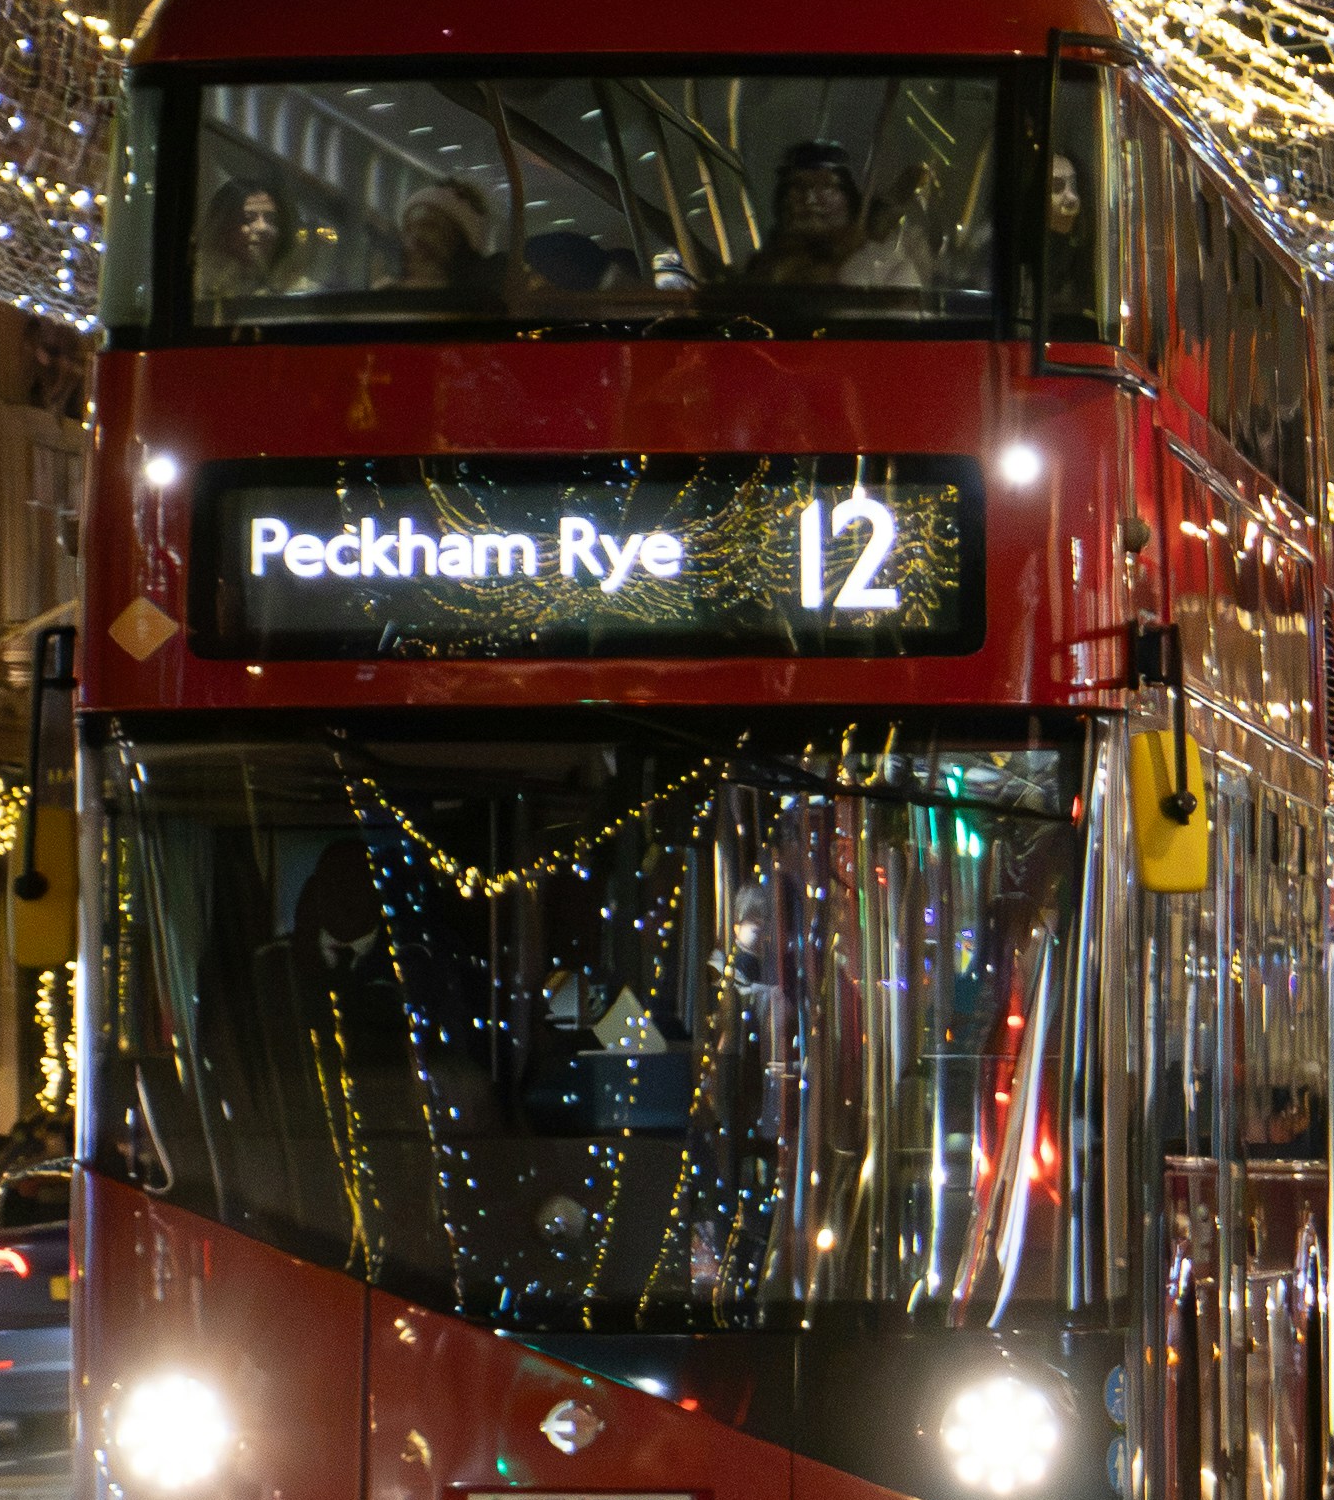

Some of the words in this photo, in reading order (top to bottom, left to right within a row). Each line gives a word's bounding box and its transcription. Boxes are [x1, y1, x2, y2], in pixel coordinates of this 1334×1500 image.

[250, 516, 538, 578] Peckham
[558, 516, 685, 593] Rye
[799, 498, 901, 610] 12
